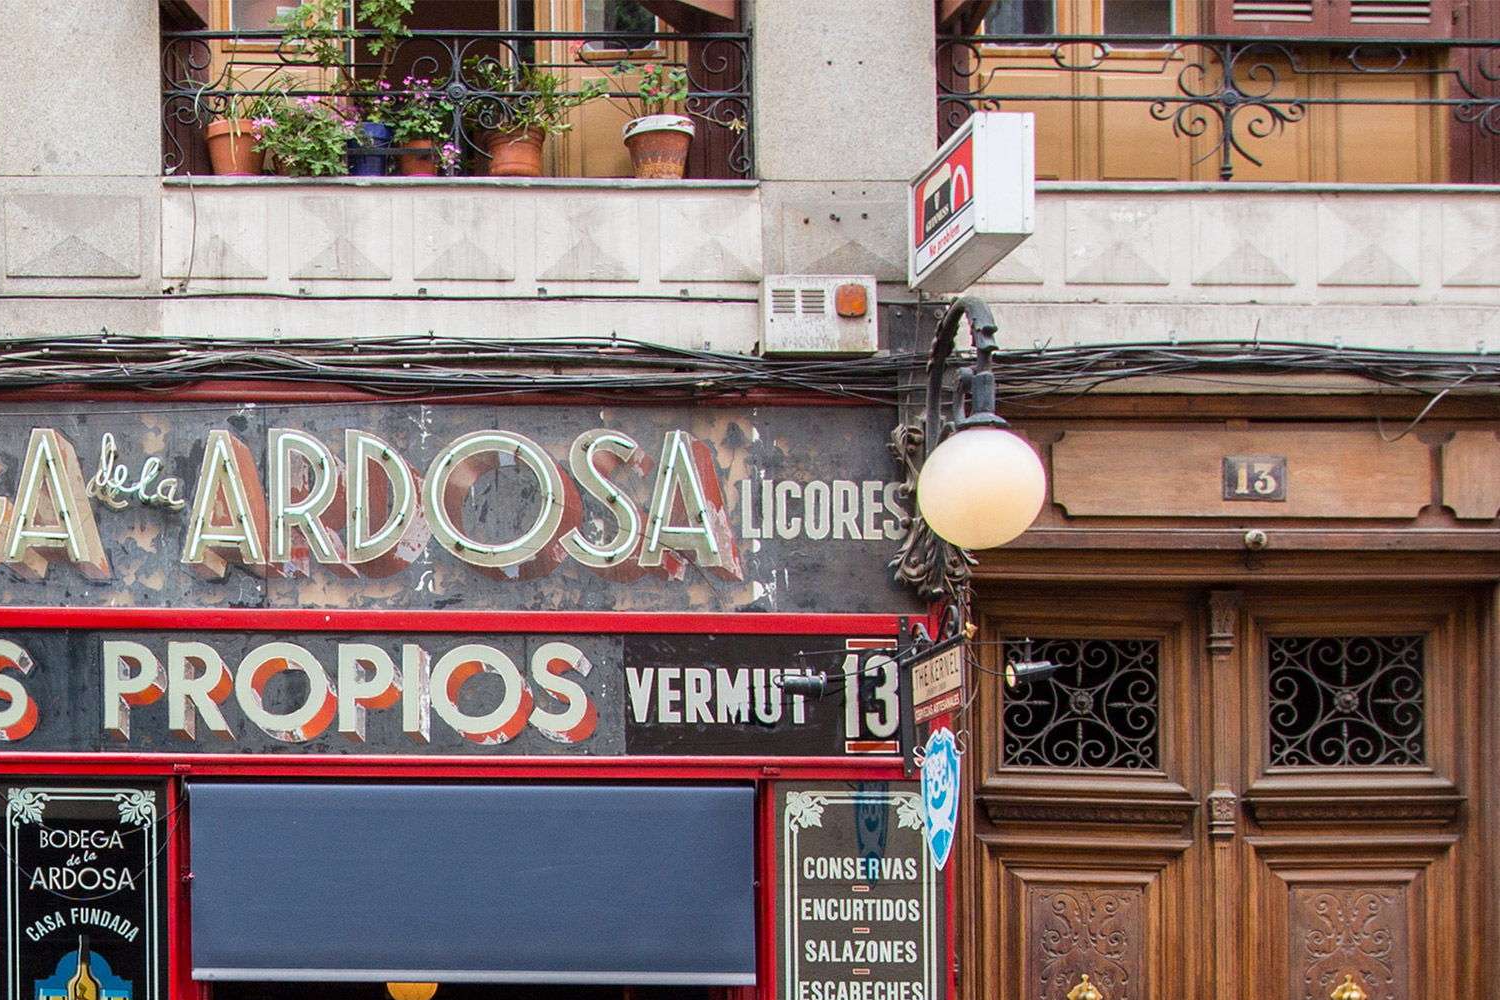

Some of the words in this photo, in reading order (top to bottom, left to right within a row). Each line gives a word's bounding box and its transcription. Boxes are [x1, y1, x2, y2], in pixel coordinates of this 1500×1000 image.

[937, 225, 960, 250] problem
[88, 432, 140, 505] de
[140, 456, 185, 508] la
[1235, 463, 1277, 494] 13
[181, 428, 728, 570] ARDOSA
[742, 479, 908, 540] LICORES
[914, 668, 929, 690] THE
[929, 652, 959, 683] KERNEL
[103, 641, 595, 738] PROPIOS
[626, 666, 811, 724] VERMUT
[842, 654, 899, 738] 13
[40, 830, 124, 849] BODEGA
[66, 854, 81, 866] de
[84, 850, 97, 862] la
[803, 857, 918, 880] CONSERVAS
[29, 867, 136, 890] ARDOSA
[25, 911, 66, 942] CASA
[70, 907, 139, 943] FUNDADA
[801, 899, 920, 922] ENCURTIDOS
[805, 940, 918, 963] SALAZONES
